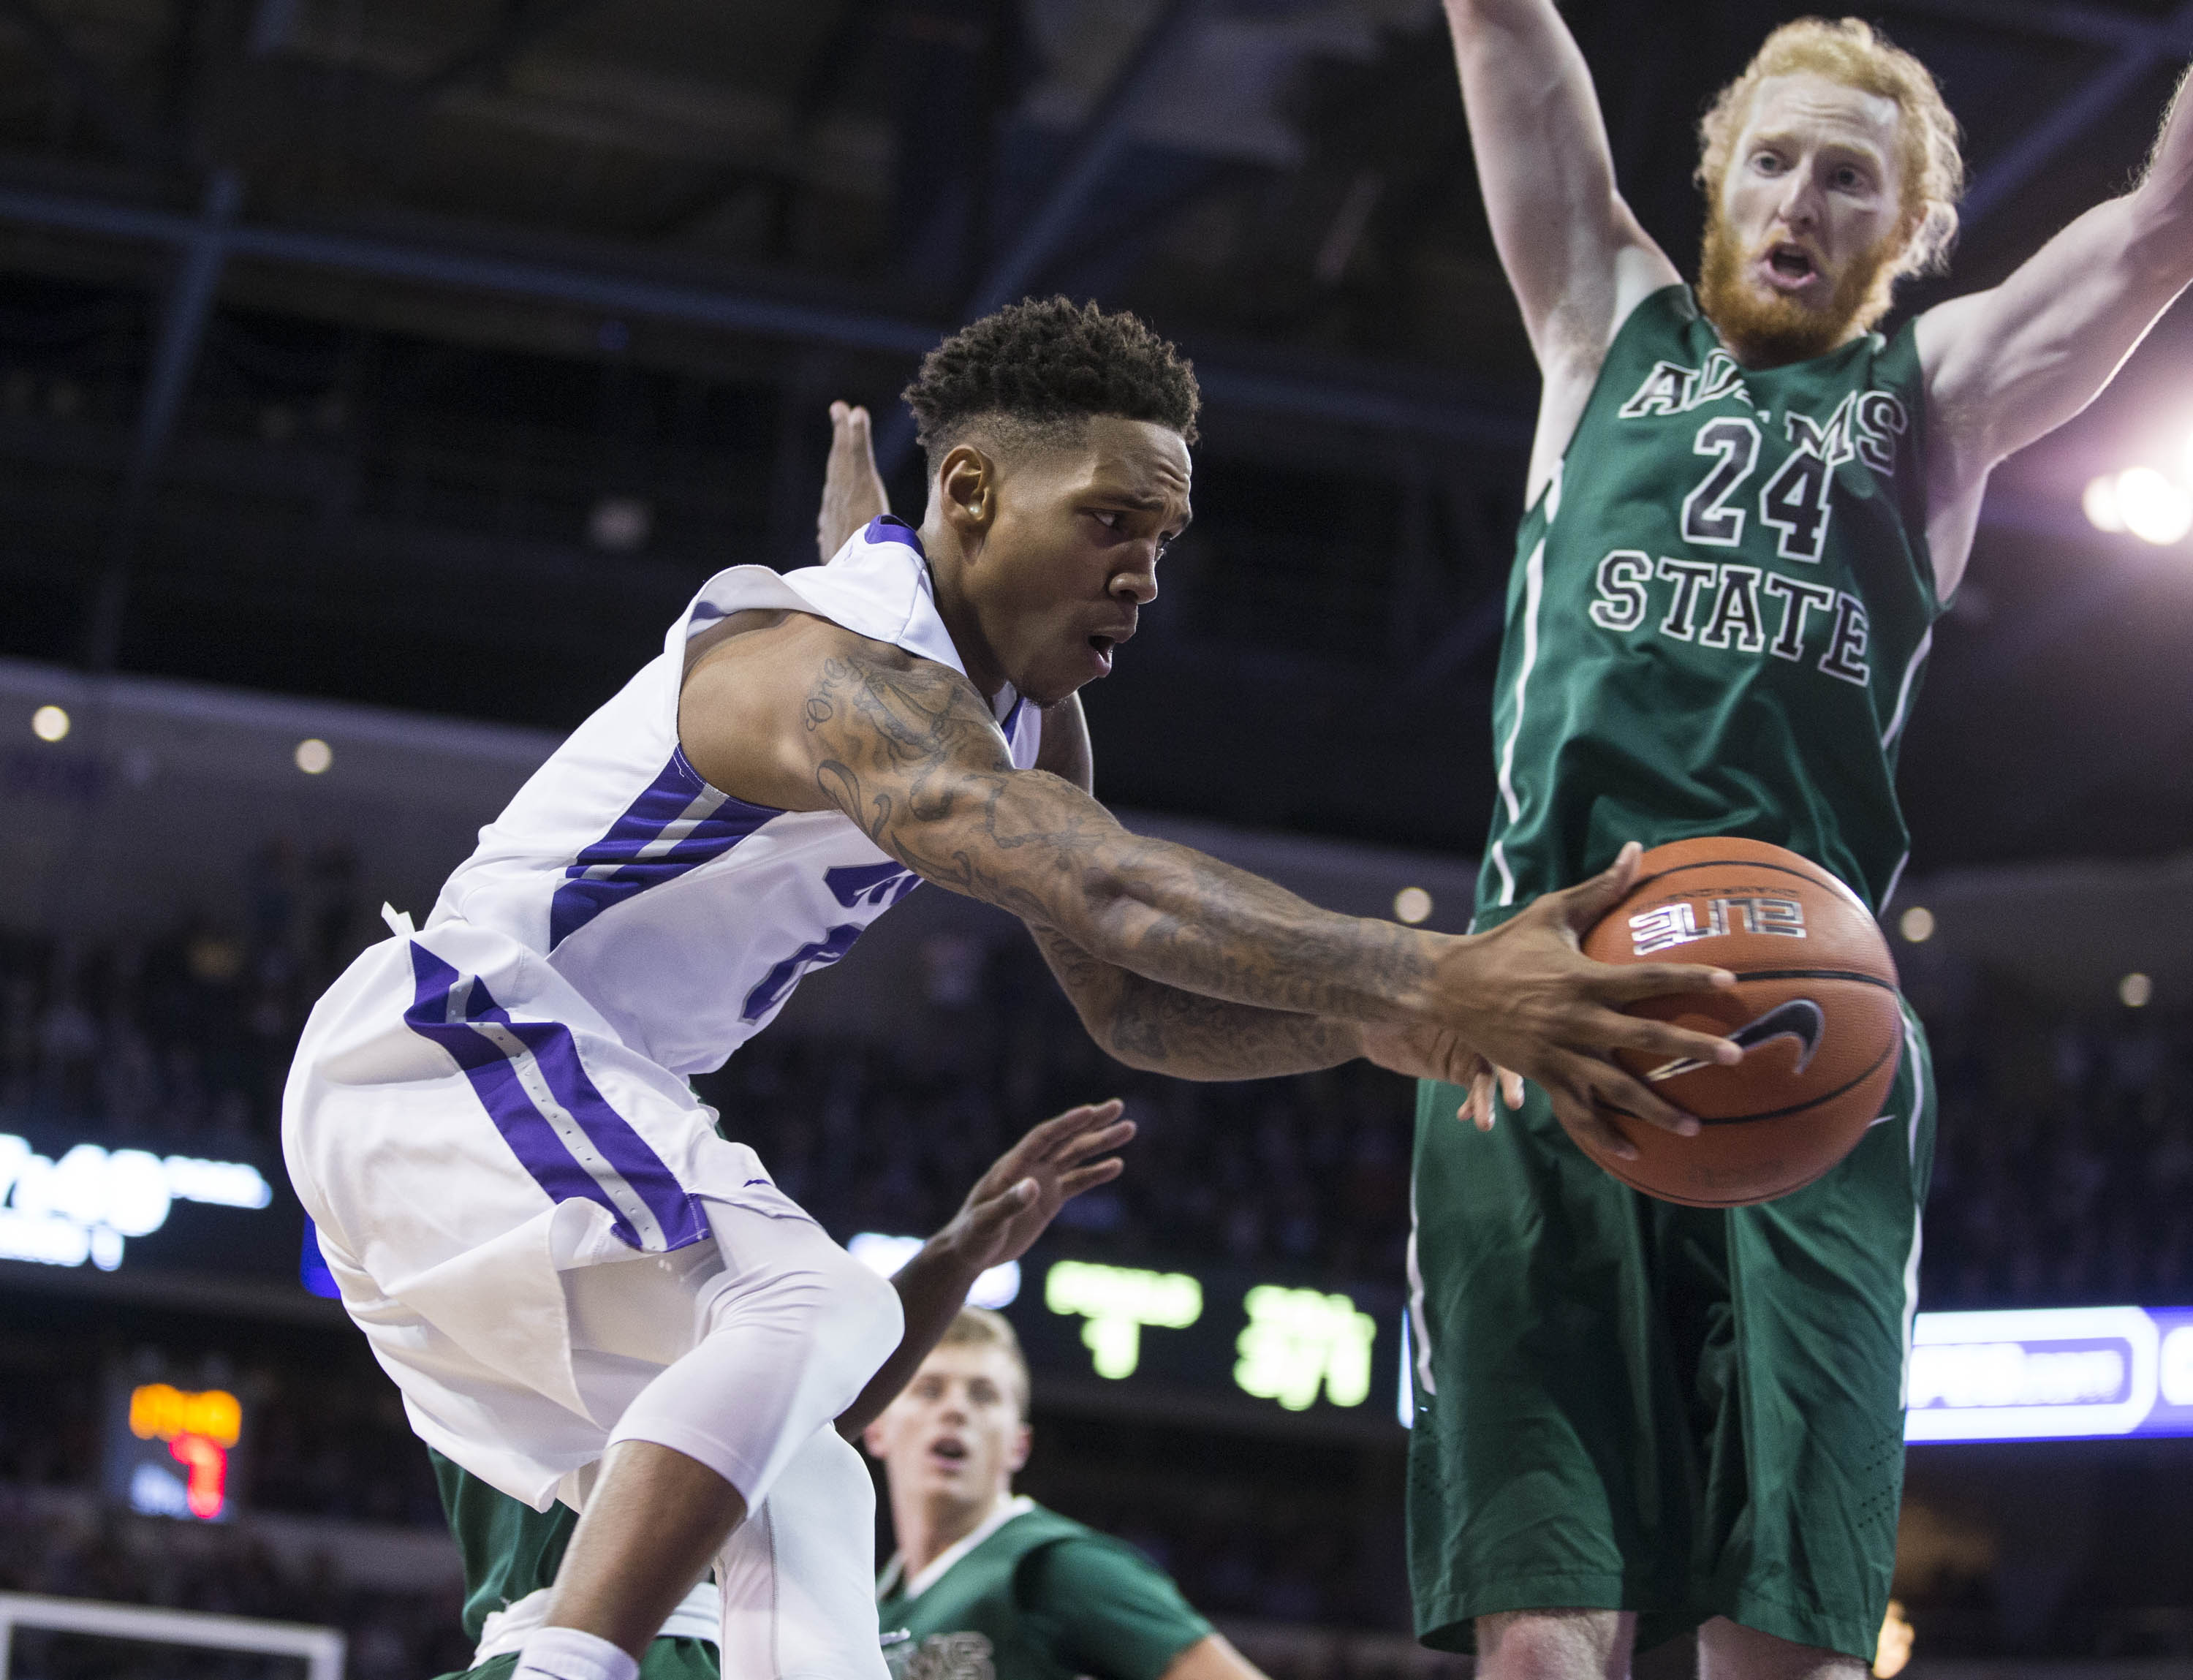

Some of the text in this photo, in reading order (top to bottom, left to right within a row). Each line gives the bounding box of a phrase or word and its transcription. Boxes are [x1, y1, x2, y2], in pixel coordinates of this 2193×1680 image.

[1618, 347, 1908, 477] ADMS
[1681, 416, 1833, 563] 24
[1589, 550, 1871, 686] STATE
